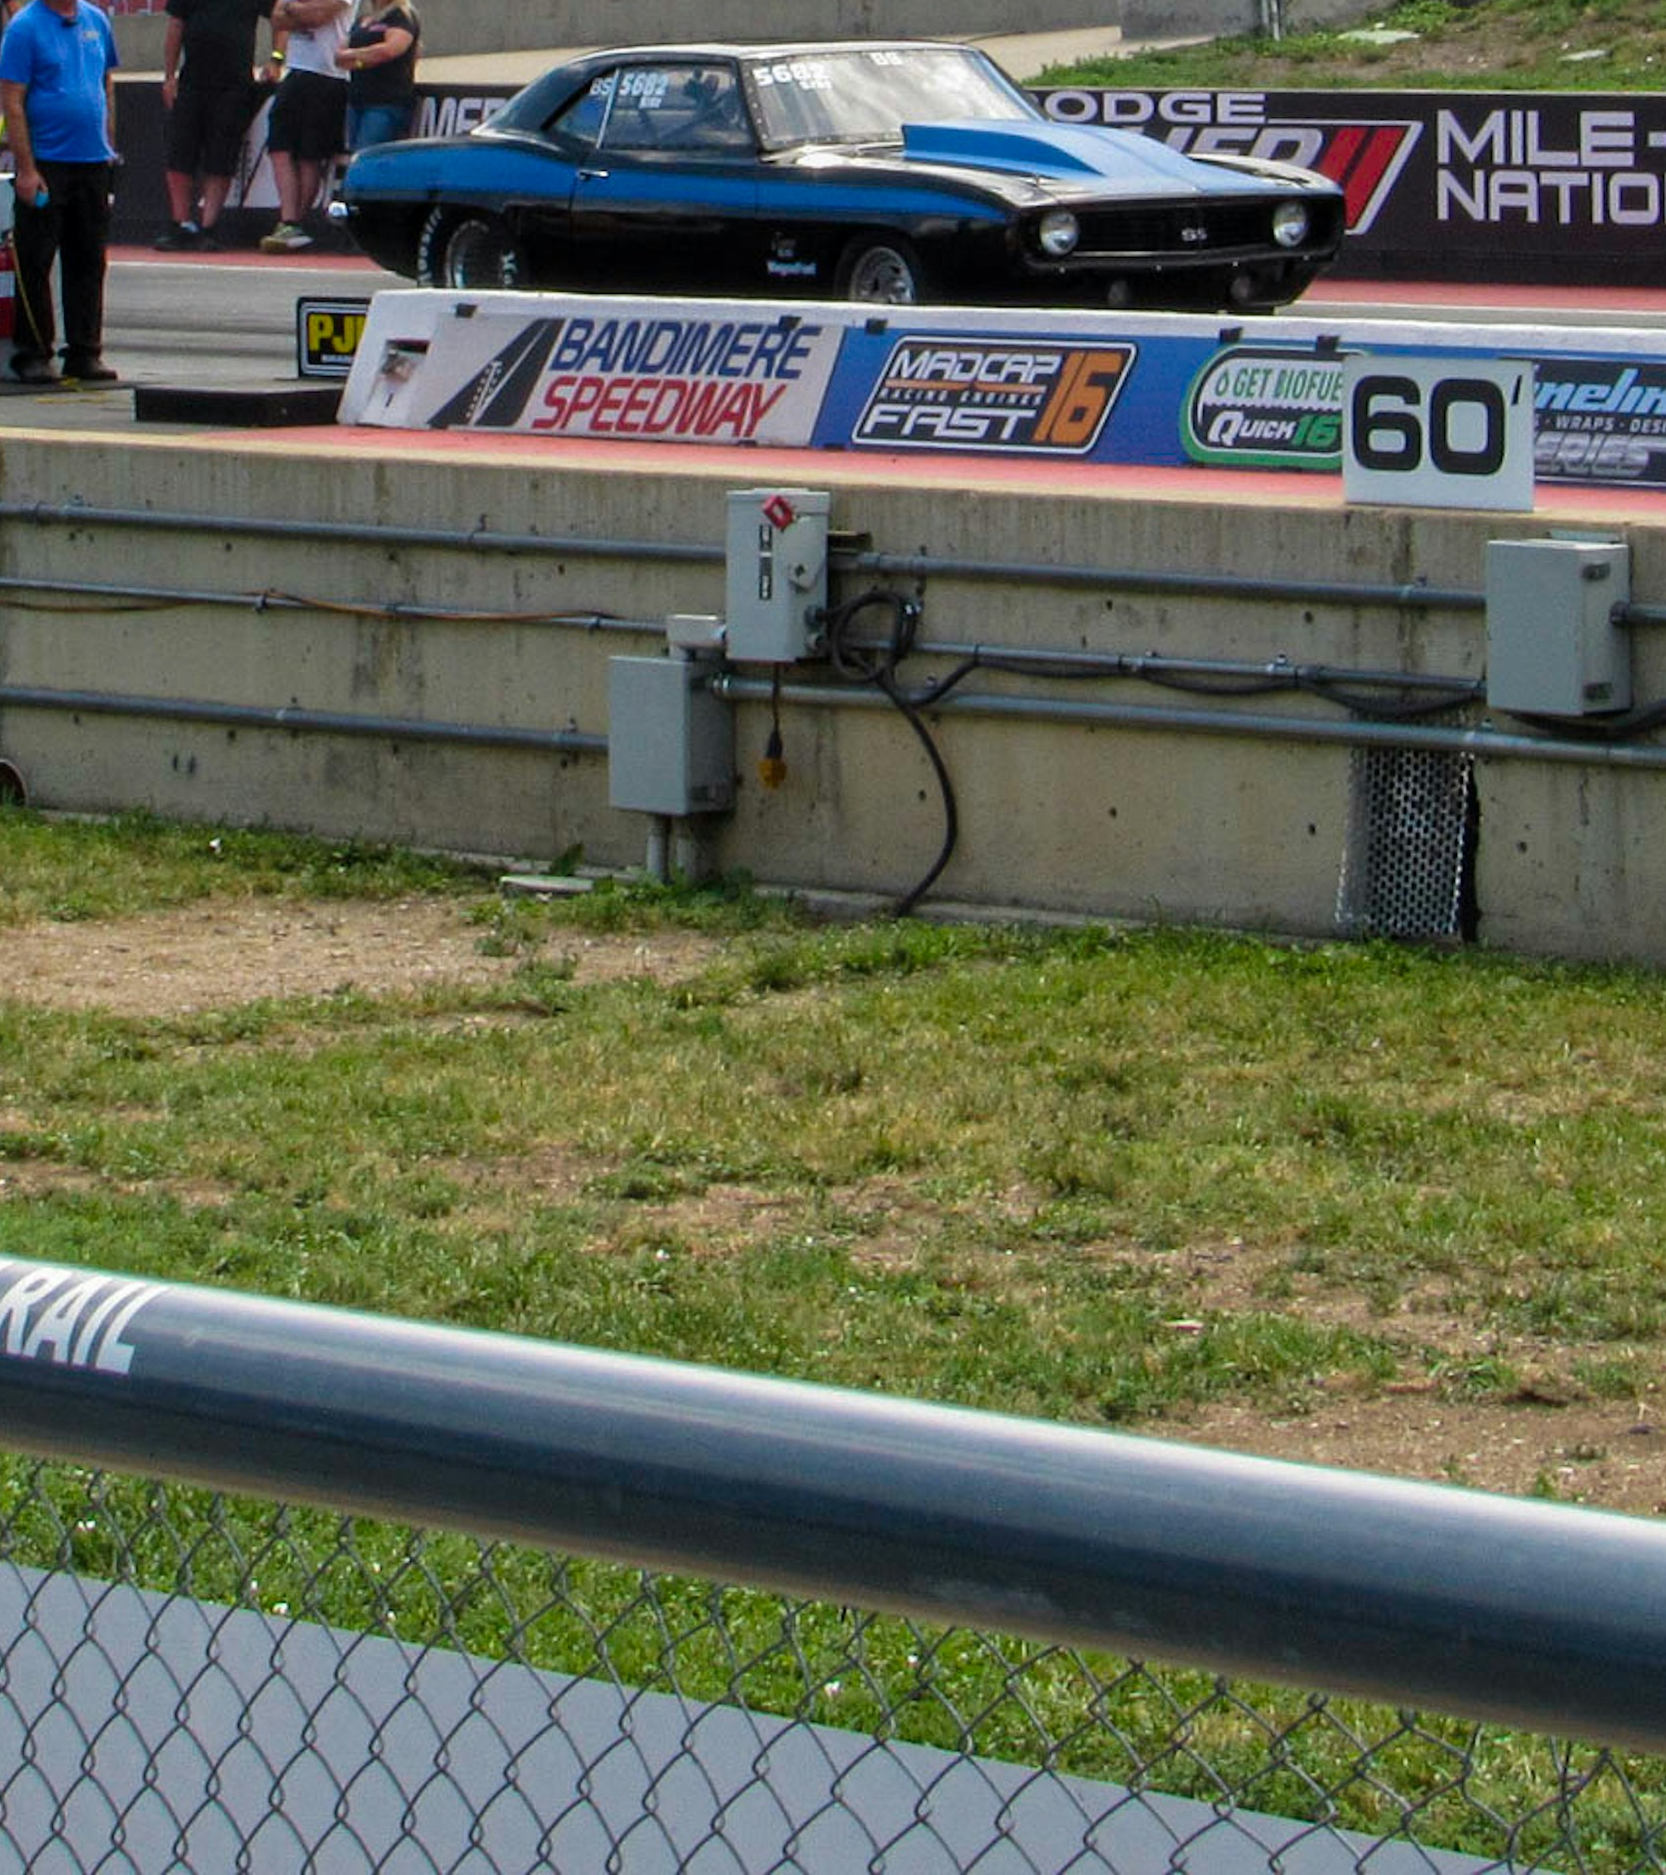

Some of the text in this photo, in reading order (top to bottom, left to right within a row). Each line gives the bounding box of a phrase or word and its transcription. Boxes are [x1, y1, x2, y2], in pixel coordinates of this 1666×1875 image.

[618, 72, 670, 96] 5682
[549, 318, 824, 380] BANDIMERE
[879, 386, 1045, 407] RACING ENGINES
[889, 348, 1124, 444] MADCAP 16
[1233, 366, 1272, 398] GET
[531, 375, 788, 439] SPEEDWAY
[862, 403, 1037, 441] FAST
[1555, 415, 1615, 432] WRAPS
[1290, 413, 1342, 449] 16
[1534, 430, 1650, 477] ERIES
